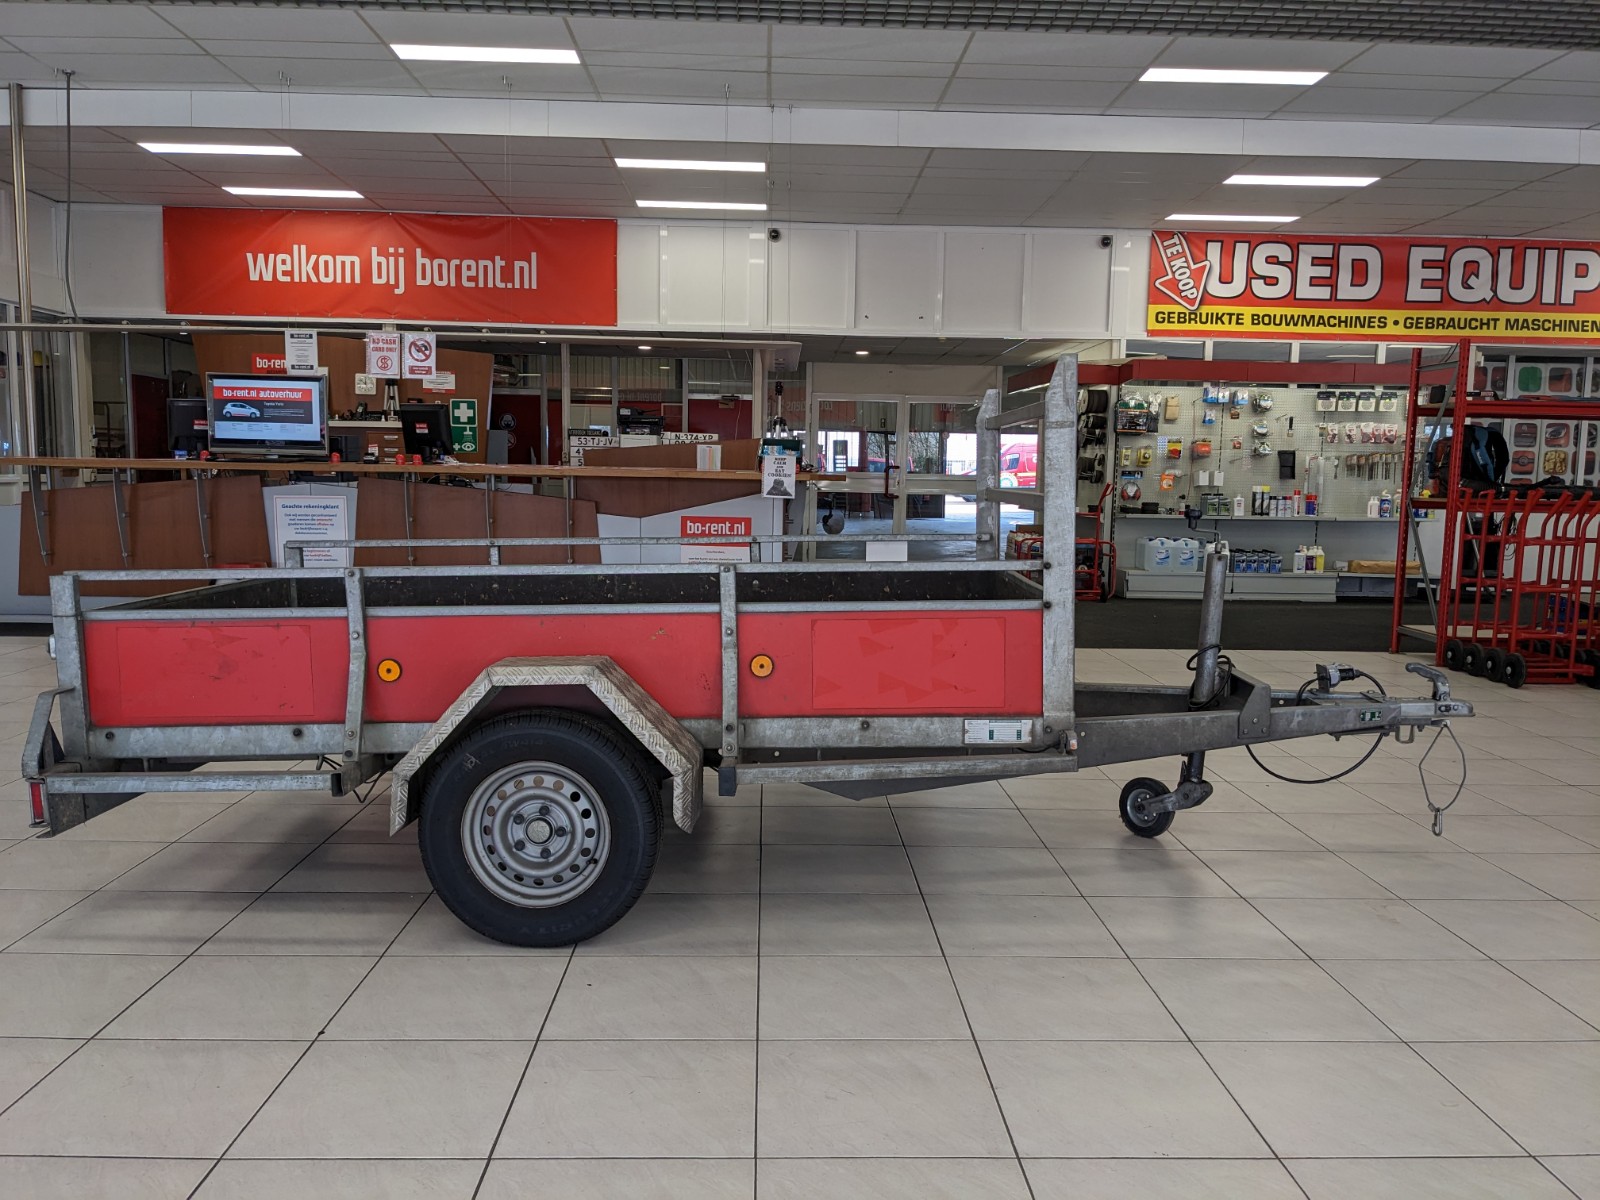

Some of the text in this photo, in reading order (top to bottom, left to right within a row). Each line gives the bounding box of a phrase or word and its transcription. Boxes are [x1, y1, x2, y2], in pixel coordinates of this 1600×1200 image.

[246, 244, 538, 295] welkom bij borent.nl
[1162, 235, 1198, 300] TE KOOP
[1204, 240, 1600, 306] USED EQUIP
[1154, 310, 1600, 333] GEBRUIKTE BOUWMACHINES GEBRAUCHT MASCHINEN
[222, 388, 303, 399] bo-rent.nl autoverhuur
[577, 437, 613, 446] 53-TJ-JV
[686, 520, 745, 535] bo-rent.nl
